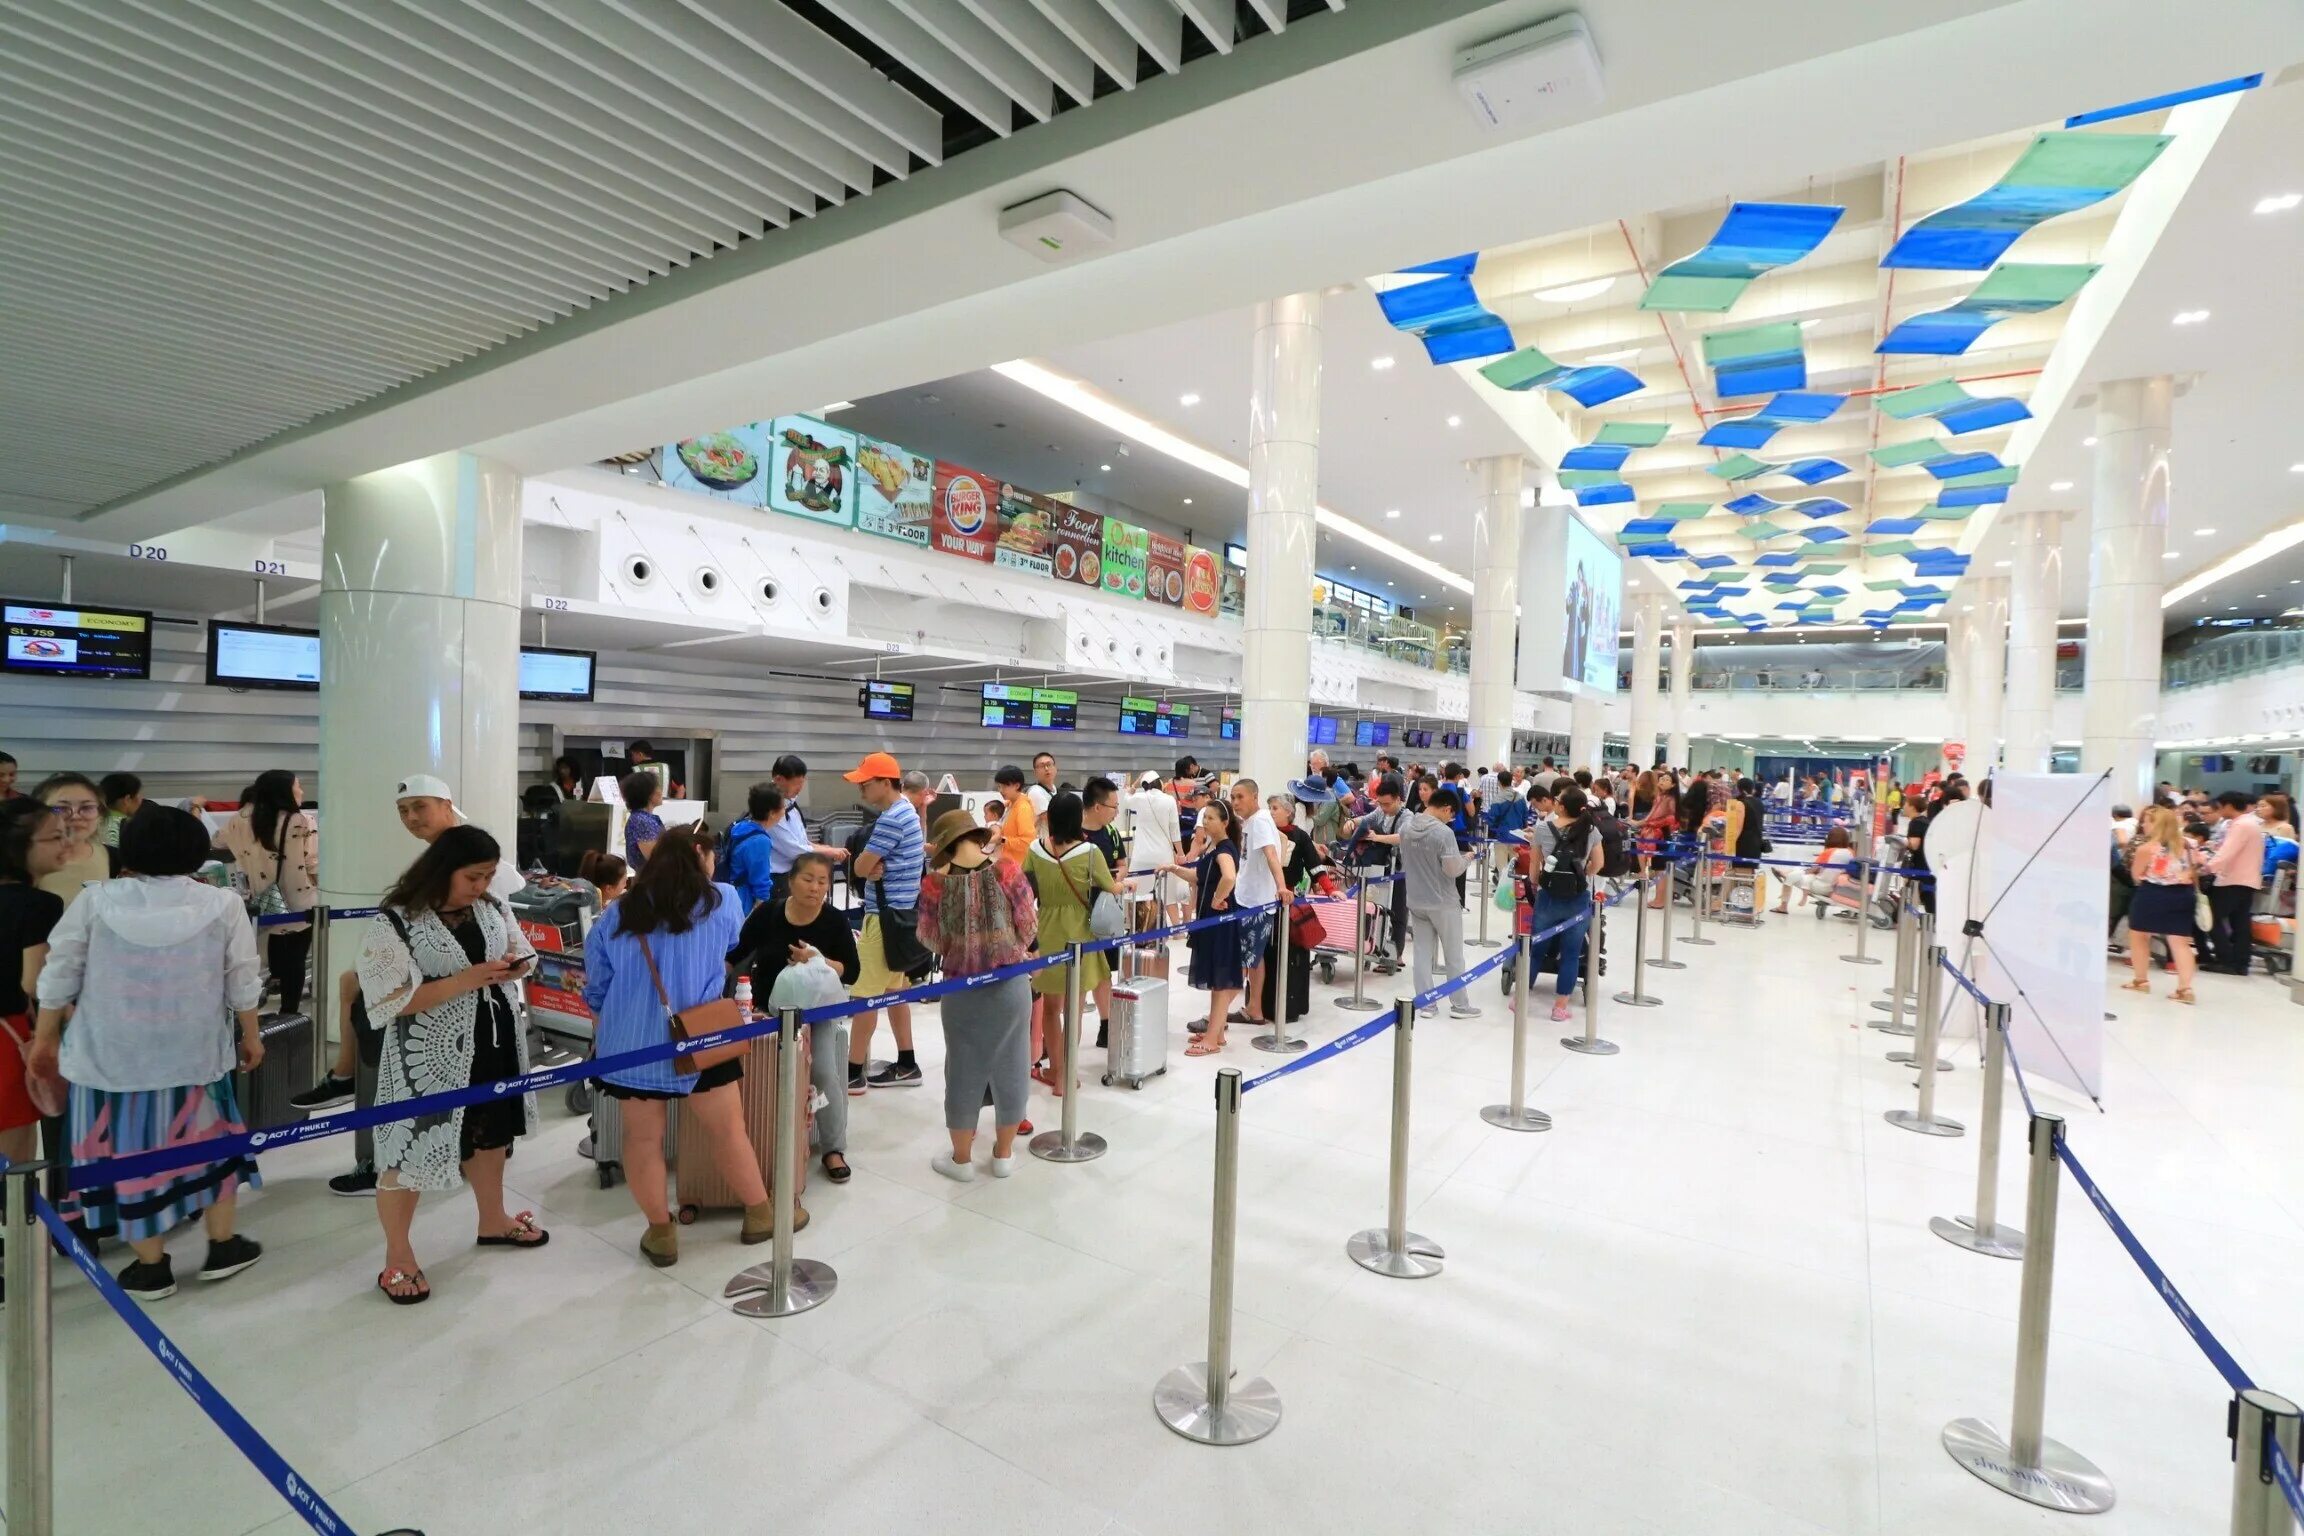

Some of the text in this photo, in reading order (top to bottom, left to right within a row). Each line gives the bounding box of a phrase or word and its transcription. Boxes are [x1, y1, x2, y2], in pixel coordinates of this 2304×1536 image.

[951, 491, 980, 502] BURGER
[952, 503, 981, 517] KING
[1064, 509, 1098, 534] Food
[898, 525, 925, 540] FLOOR
[1057, 528, 1099, 546] connection
[941, 532, 985, 556] YOUR WAY
[1105, 544, 1144, 570] kitchen
[1029, 560, 1049, 573] FLOOR
[86, 618, 136, 627] ECONOMY
[11, 627, 55, 637] SL 759
[507, 1080, 522, 1089] AOT
[530, 1073, 554, 1084] PHUKET
[268, 1129, 289, 1140] AOT
[299, 1121, 331, 1133] PHUKET
[297, 1487, 310, 1505] AOT
[315, 1504, 336, 1534] PHUKET
